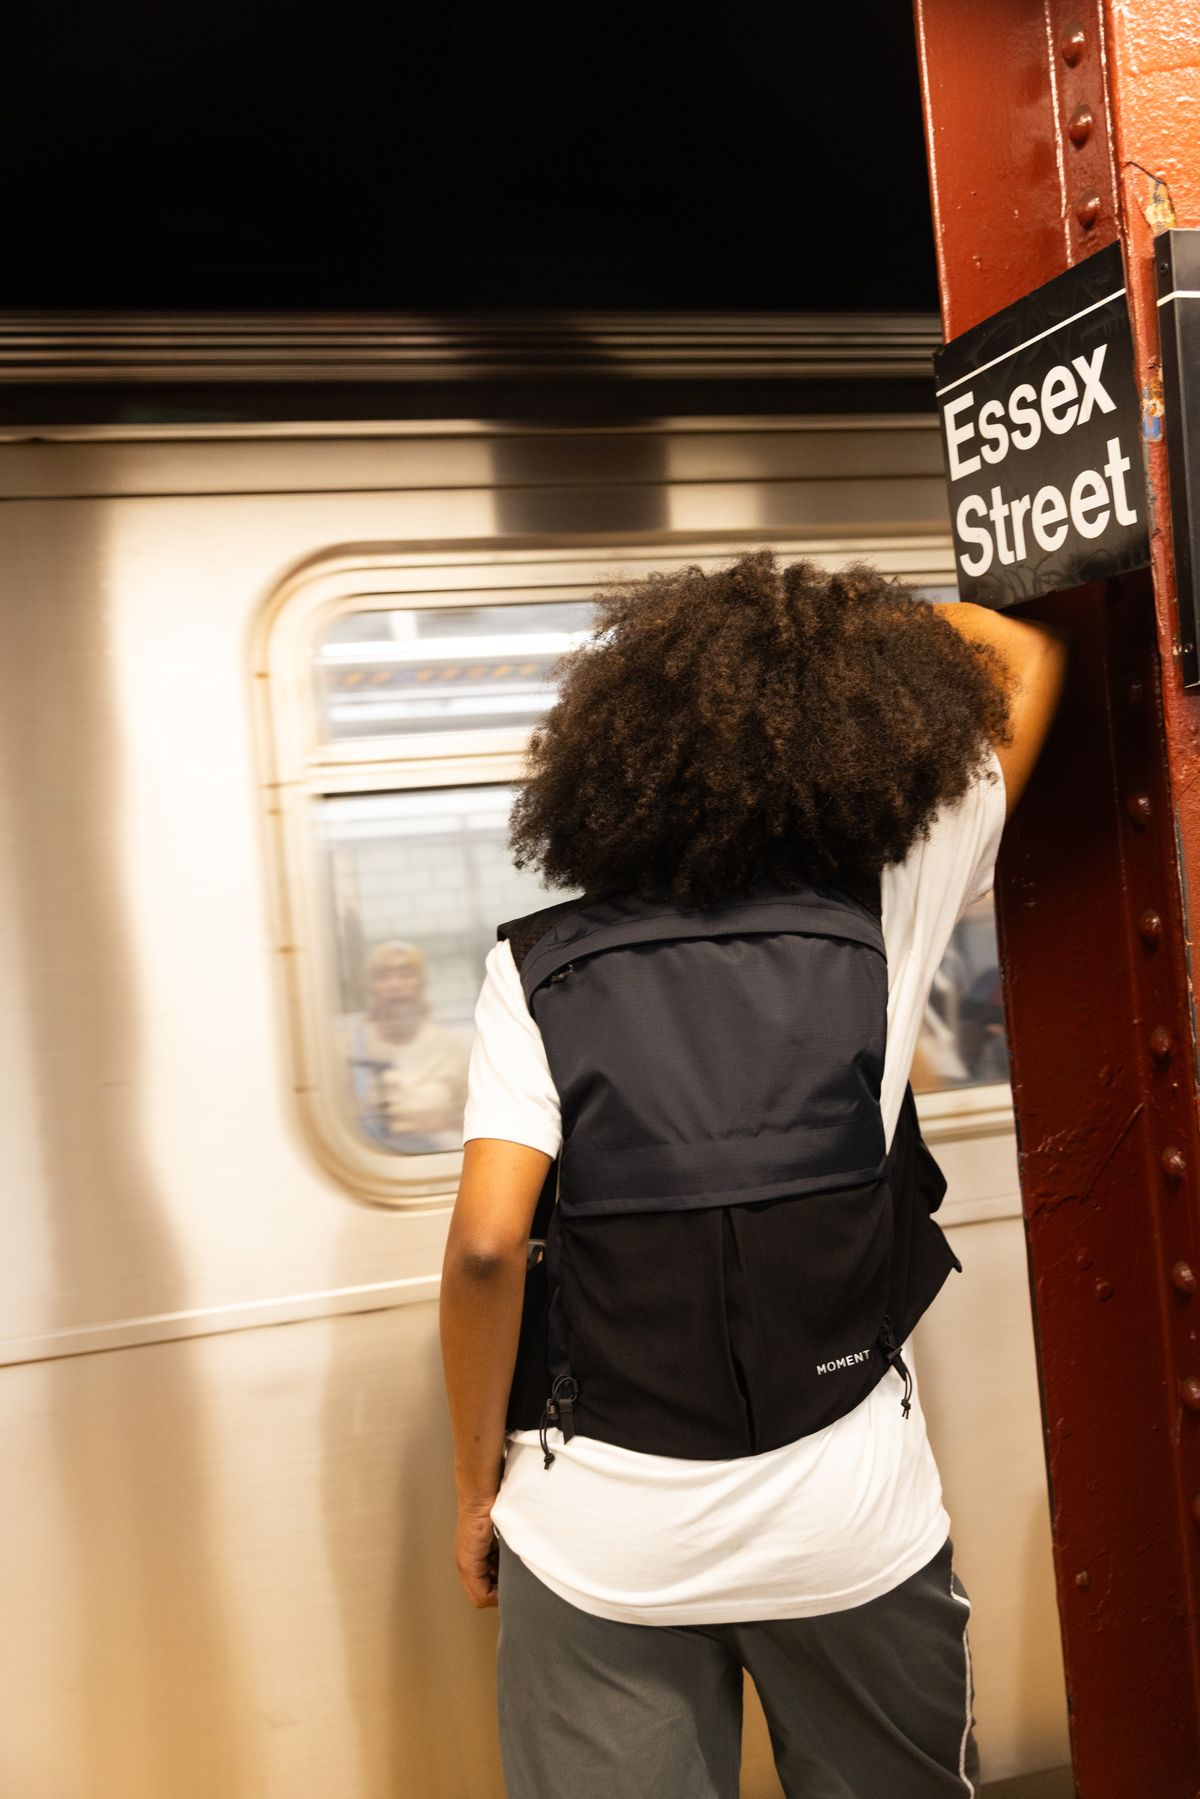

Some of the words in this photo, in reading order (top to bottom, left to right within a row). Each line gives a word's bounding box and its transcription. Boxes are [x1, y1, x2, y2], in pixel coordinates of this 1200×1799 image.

[944, 344, 1117, 481] Essex
[956, 437, 1138, 577] Street
[816, 1349, 870, 1375] MOMENT
